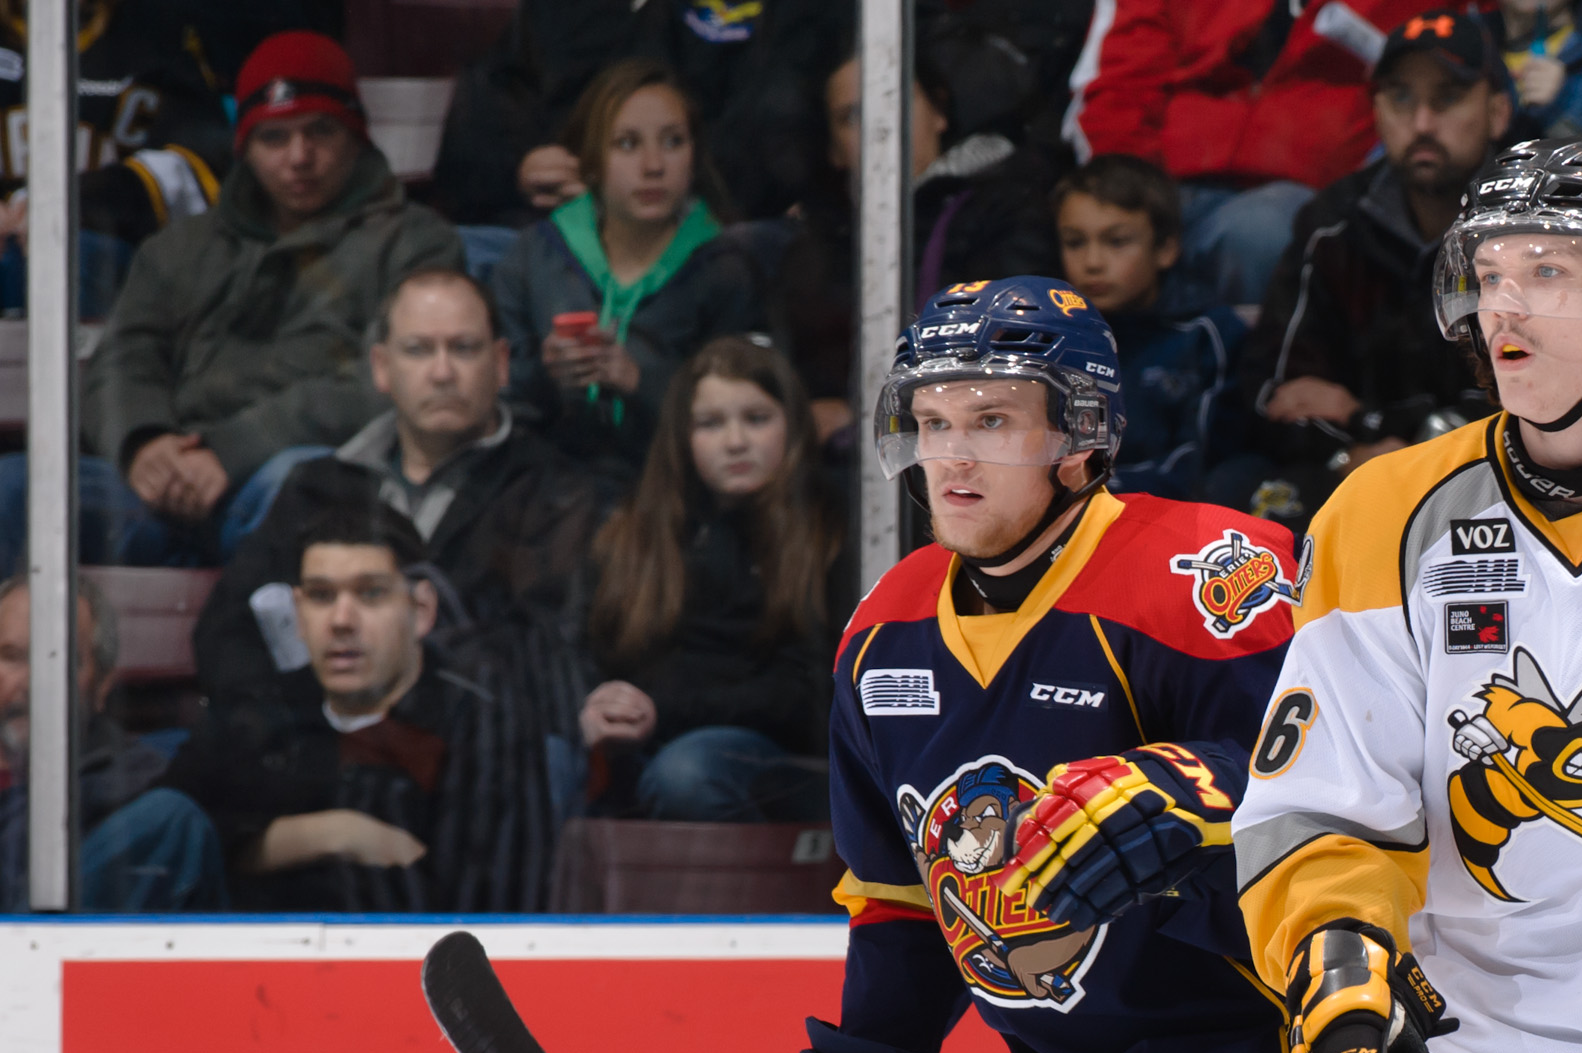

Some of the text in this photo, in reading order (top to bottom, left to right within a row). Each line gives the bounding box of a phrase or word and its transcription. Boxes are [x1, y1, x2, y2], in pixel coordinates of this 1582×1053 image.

[1479, 177, 1534, 195] CCM
[920, 321, 981, 339] CCM
[1085, 361, 1116, 378] CCM
[1073, 399, 1100, 408] BAUER
[1456, 523, 1511, 550] VOZ
[1201, 552, 1278, 624] OTTERS
[1450, 610, 1470, 618] JUNO
[1450, 623, 1476, 631] CENTRE
[1029, 681, 1106, 708] CCM
[1249, 687, 1320, 780] 6
[1411, 965, 1442, 1008] CCM
[1413, 984, 1428, 1003] PRO
